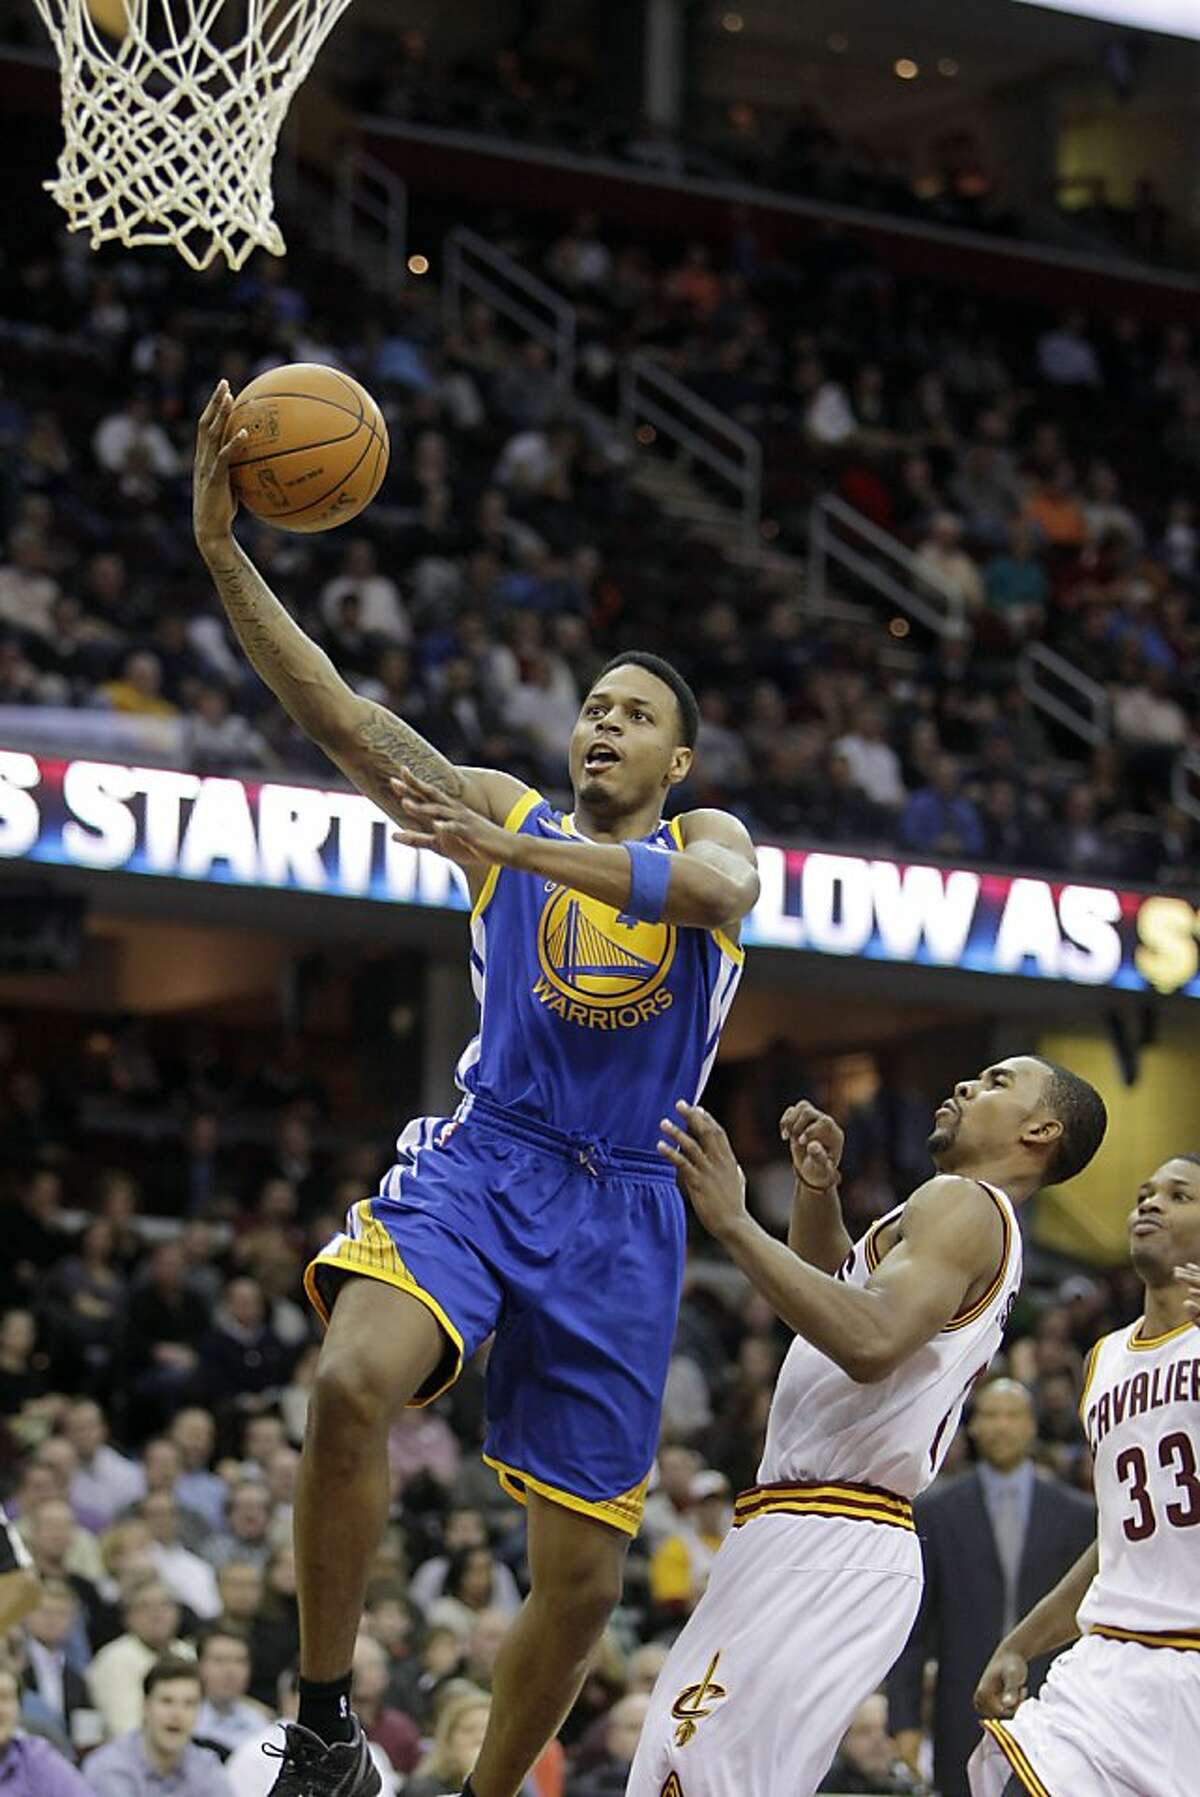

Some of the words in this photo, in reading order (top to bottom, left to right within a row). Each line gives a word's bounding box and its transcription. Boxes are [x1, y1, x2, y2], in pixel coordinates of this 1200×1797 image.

[751, 845, 980, 966] LOW
[996, 877, 1123, 985] AS
[532, 976, 673, 1030] WARRIORS
[1116, 1431, 1200, 1542] 33
